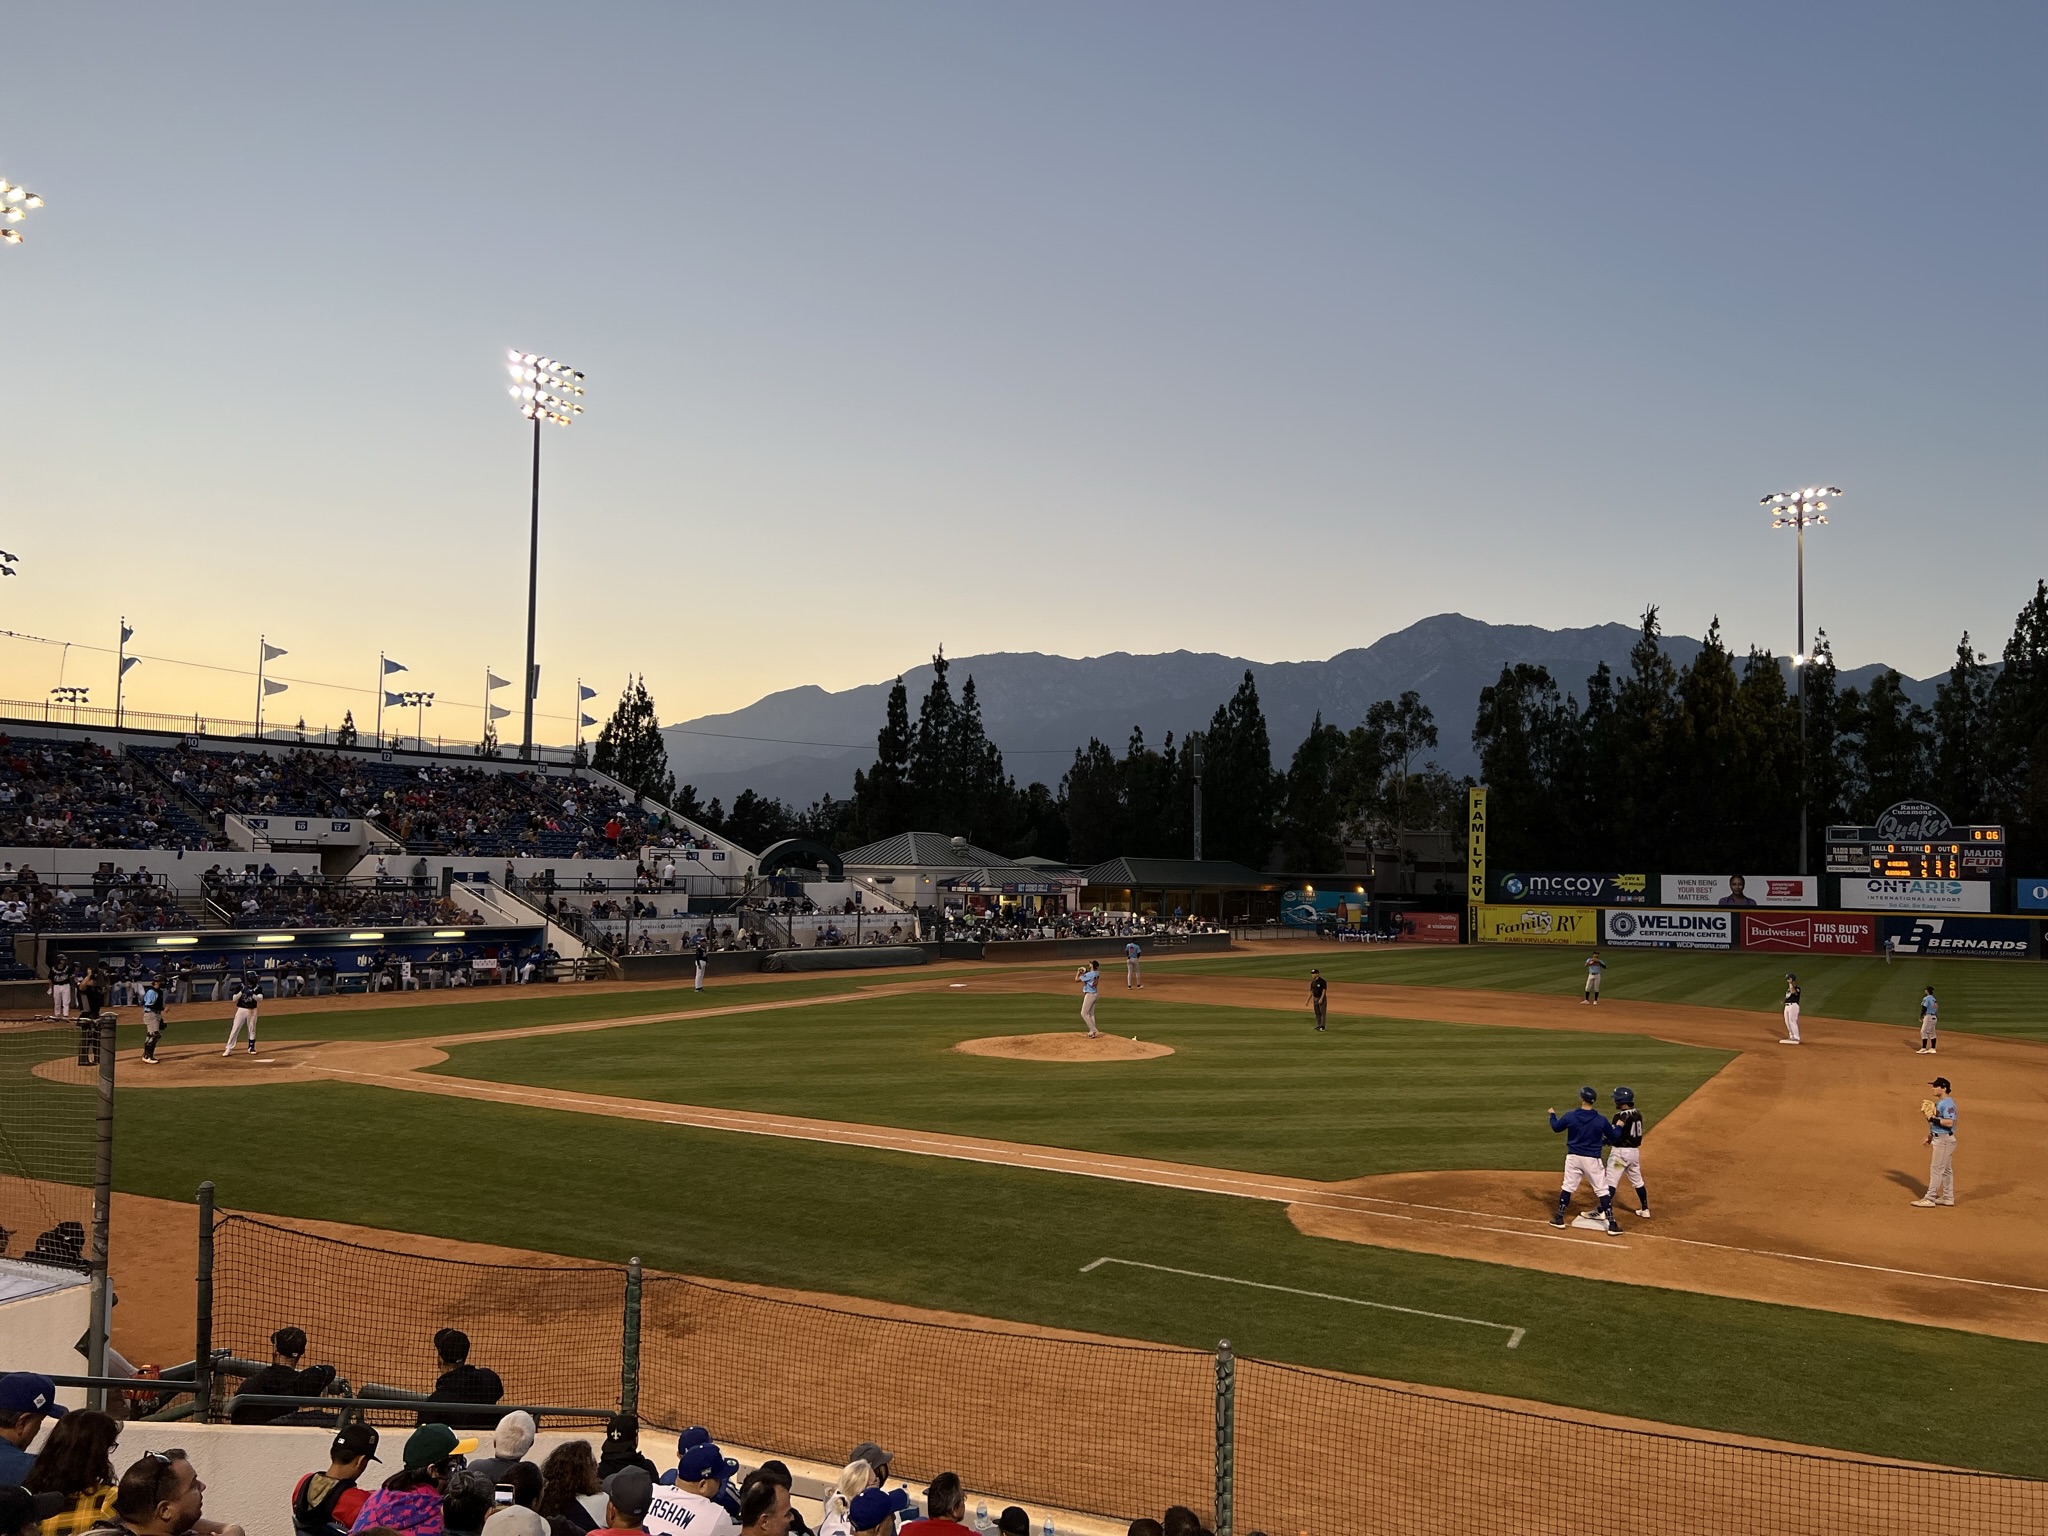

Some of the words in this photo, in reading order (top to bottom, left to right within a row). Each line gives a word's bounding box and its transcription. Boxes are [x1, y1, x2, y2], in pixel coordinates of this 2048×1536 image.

[1472, 800, 1484, 868] FAMILY
[1878, 814, 1948, 842] Quakes
[1888, 844, 1894, 853] 0
[1924, 845, 1931, 854] 0
[1951, 845, 1958, 854] 0
[1874, 860, 1880, 868] 6
[1936, 861, 1942, 869] 3
[1950, 861, 1956, 869] 2
[1921, 869, 1928, 878] 5
[1950, 870, 1956, 878] 0
[1472, 876, 1482, 896] RV
[1530, 876, 1605, 897] mccoy
[1867, 880, 1962, 895] ONTARIO
[1496, 916, 1551, 935] Family
[1556, 916, 1583, 932] RV
[1638, 915, 1726, 930] WELDING
[1814, 923, 1836, 933] THIS
[1839, 924, 1868, 934] BUD'S
[1814, 934, 1832, 943] FOR
[1835, 934, 1858, 944] YOU.
[1928, 938, 2028, 950] BERNARDS
[1630, 1120, 1643, 1138] 48
